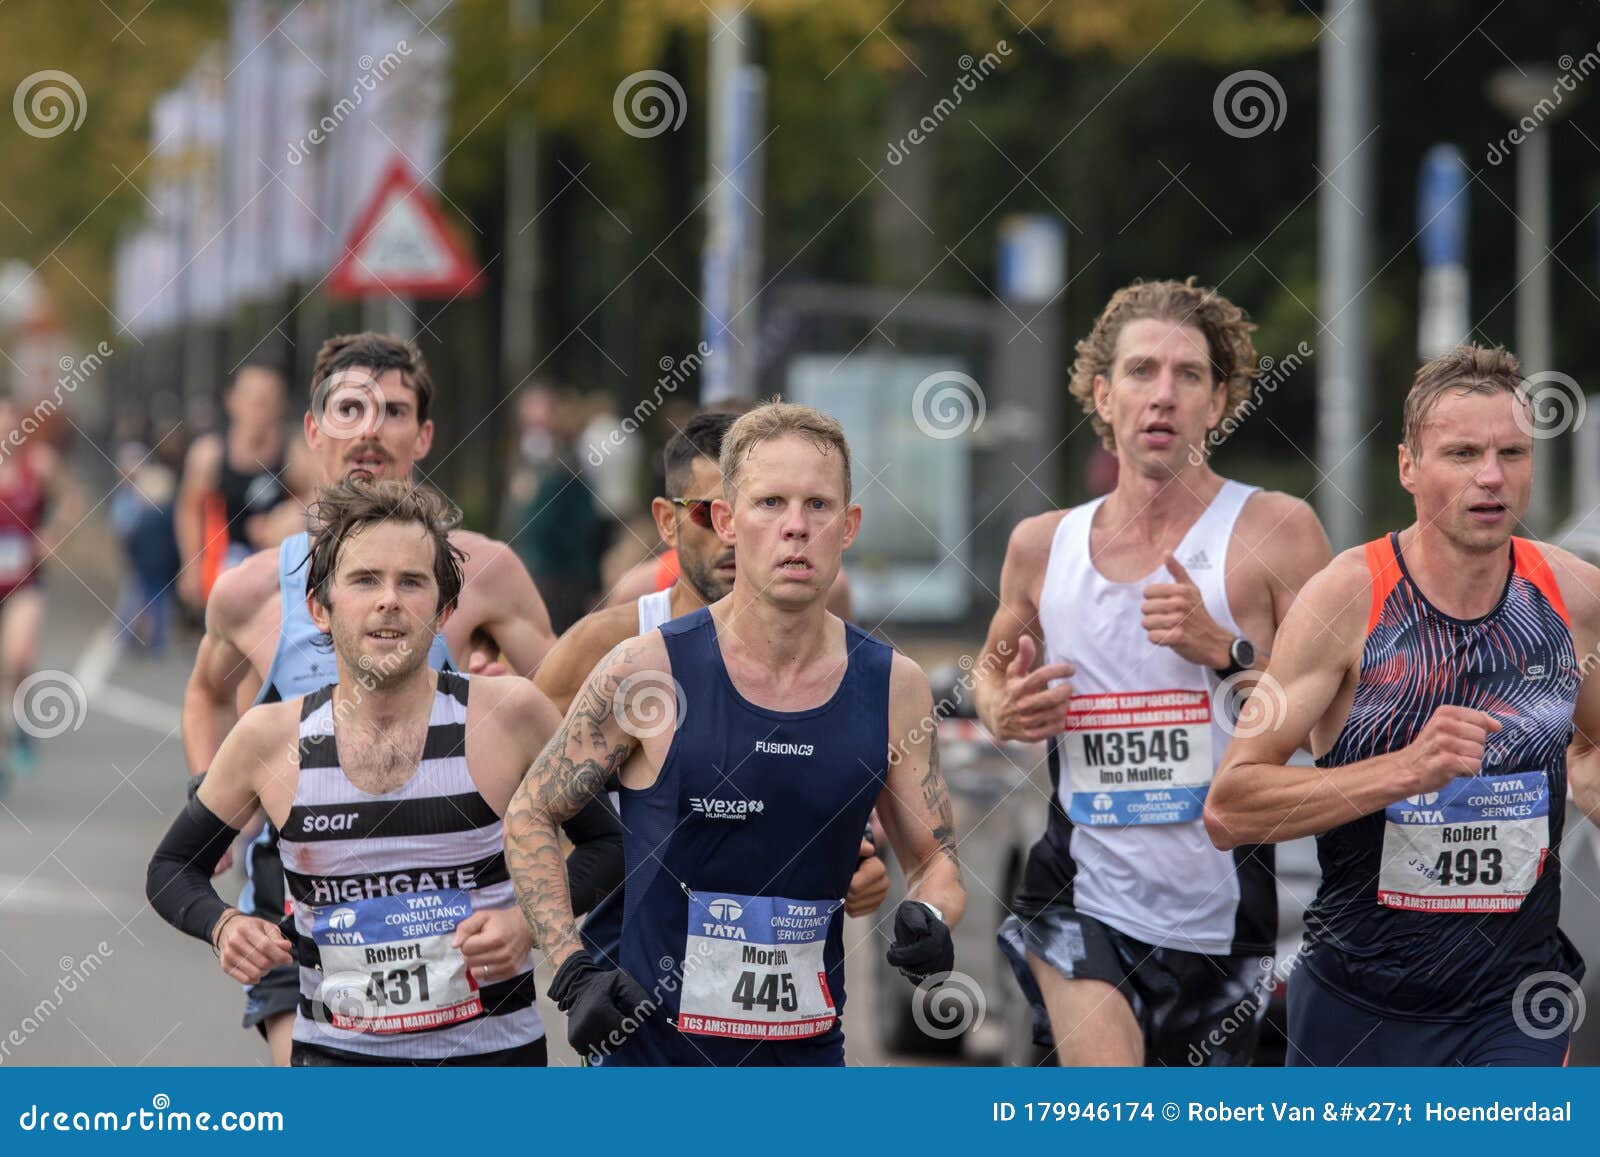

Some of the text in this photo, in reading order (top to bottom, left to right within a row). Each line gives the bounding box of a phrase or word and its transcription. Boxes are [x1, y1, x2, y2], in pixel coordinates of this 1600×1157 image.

[1083, 728, 1190, 767] M3546
[1100, 767, 1173, 784] Imo Muller
[1492, 779, 1524, 792] TATA
[1144, 791, 1172, 802] TATA
[1468, 790, 1544, 807] CONSULTANCY
[702, 798, 748, 813] Vexa
[1481, 805, 1532, 818] SERVICES
[302, 812, 359, 833] soar
[1089, 813, 1118, 825] TATA
[1401, 810, 1445, 824] TATA
[1442, 825, 1498, 843] Robert
[1434, 848, 1503, 887] 493
[311, 865, 477, 903] HIGHGATE
[407, 895, 442, 909] TATA
[1382, 893, 1403, 906] TCS
[1404, 896, 1465, 910] AMSTERDAM
[385, 904, 467, 925] CONSULTANCY
[788, 904, 817, 917] TATA
[402, 919, 455, 937] SERVICES
[703, 923, 746, 940] TATA
[325, 932, 366, 945] TATA
[365, 943, 422, 965] Robert
[742, 945, 788, 966] Morten
[366, 964, 430, 1008] 431
[732, 970, 798, 1013] 445
[403, 1009, 454, 1028] MARATHON
[455, 1003, 478, 1019] 2019
[683, 1016, 703, 1029] TCS
[704, 1018, 766, 1036] AMSTERDAM
[768, 1021, 815, 1037] MARATHON
